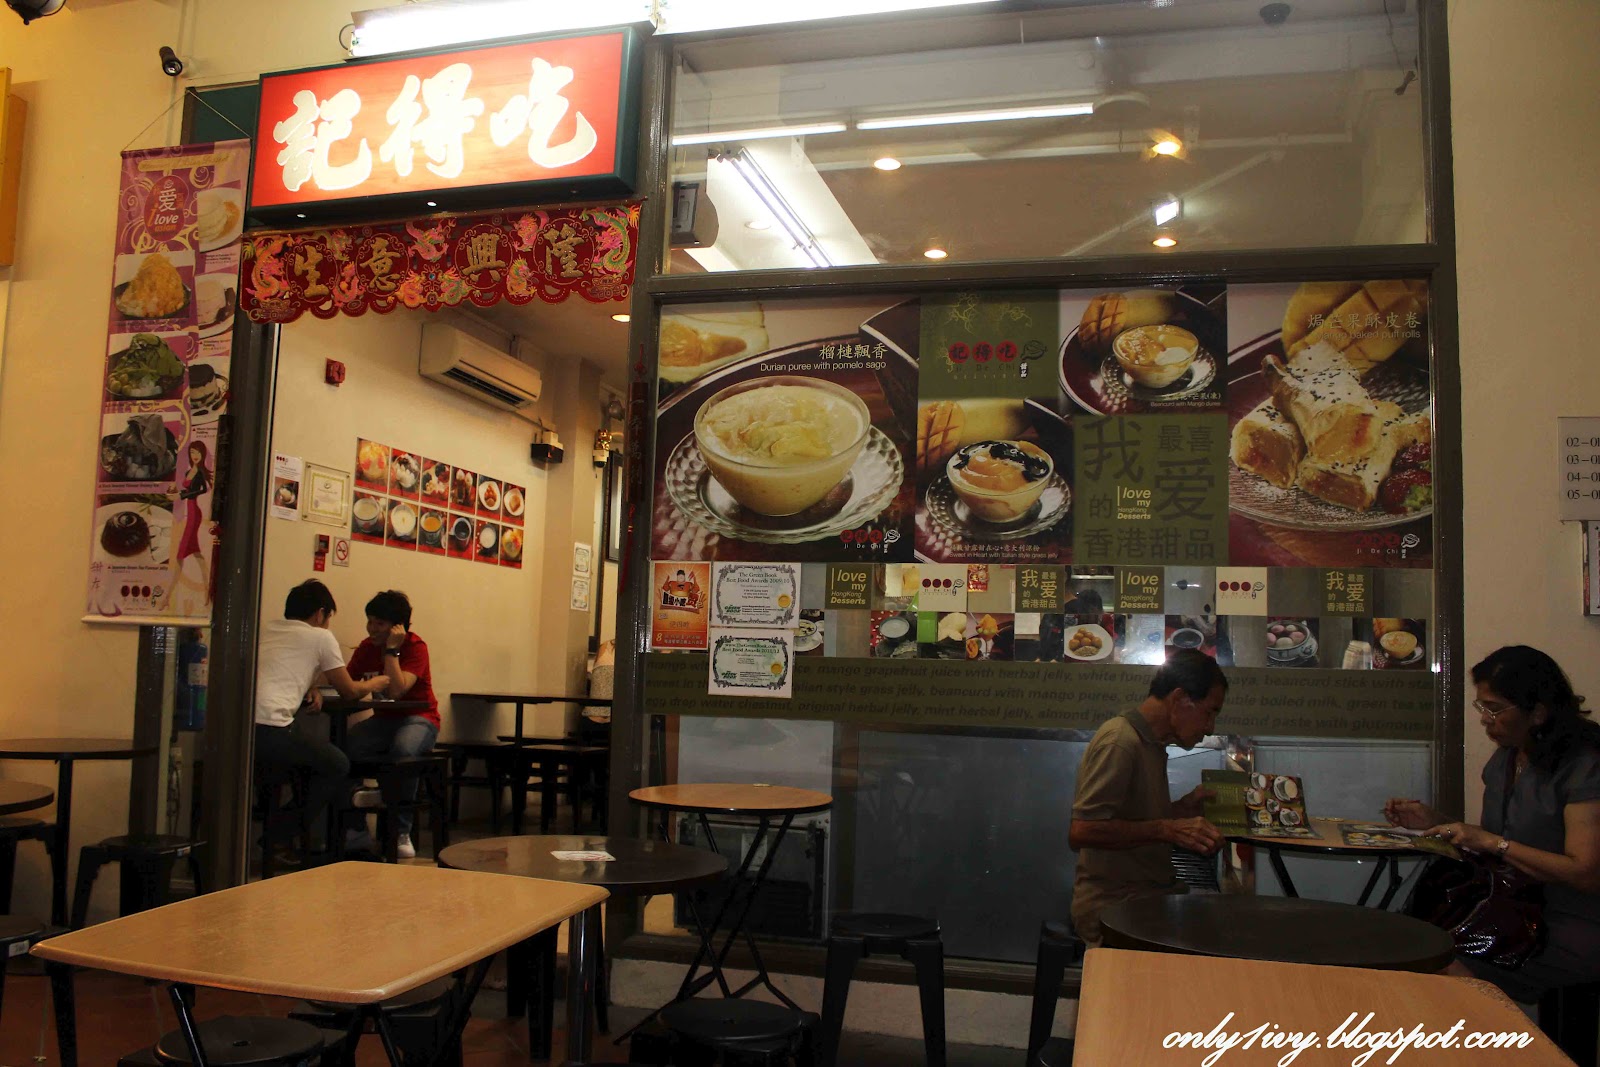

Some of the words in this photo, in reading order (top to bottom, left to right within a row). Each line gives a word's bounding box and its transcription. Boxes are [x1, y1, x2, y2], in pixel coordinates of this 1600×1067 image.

[273, 57, 597, 192] 記得吃
[158, 188, 177, 212] 爱
[154, 214, 179, 225] love
[293, 222, 584, 298] 生意興隆
[1307, 311, 1421, 329] 焗芒果酥皮卷
[1350, 331, 1379, 339] baked
[1381, 330, 1400, 339] puff
[1402, 330, 1421, 338] rolls
[760, 363, 786, 371] Durian
[789, 364, 811, 372] puree
[813, 361, 830, 370] with
[833, 361, 863, 371] pomelo
[866, 361, 886, 371] sago
[1158, 425, 1214, 452] 最喜
[1083, 416, 1144, 483] 我
[1123, 487, 1151, 499] love
[1154, 457, 1215, 520] 爱
[1089, 493, 1113, 519] 的
[1137, 500, 1151, 508] my
[1083, 527, 1215, 559] 香港甜品
[837, 569, 867, 582] love
[1022, 568, 1039, 588] 我
[1126, 572, 1158, 585] love
[1326, 571, 1345, 591] 我
[851, 583, 866, 592] my
[1040, 581, 1058, 598] 爱
[1142, 586, 1157, 595] my
[1346, 583, 1365, 602] 爱
[831, 597, 866, 605] Desserts
[965, 667, 994, 678] with
[999, 668, 1040, 679] herbal
[1372, 677, 1404, 689] with
[826, 683, 856, 695] style
[798, 701, 844, 714] original
[848, 702, 888, 713] herbal
[959, 705, 1000, 717] herbal
